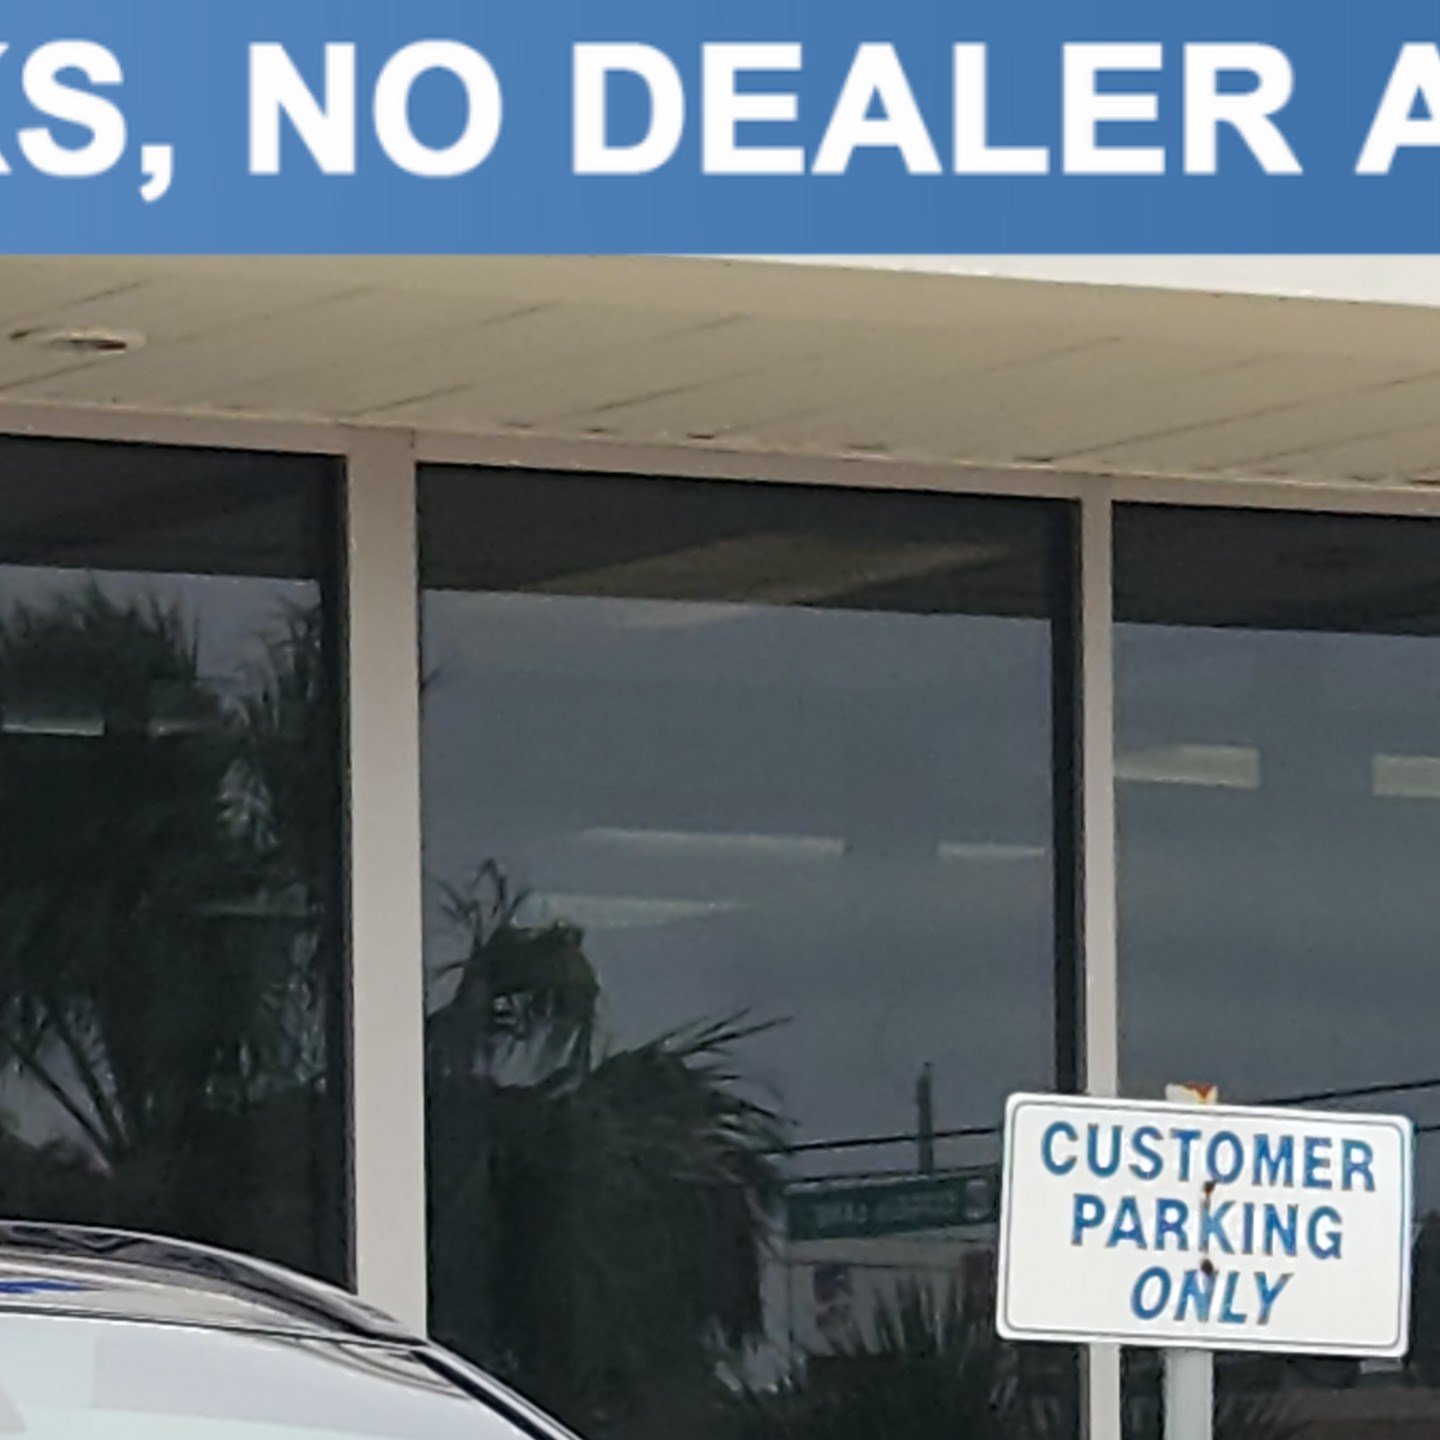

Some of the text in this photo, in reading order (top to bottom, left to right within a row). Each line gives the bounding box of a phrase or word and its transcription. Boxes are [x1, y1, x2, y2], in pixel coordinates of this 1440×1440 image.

[1041, 1120, 1377, 1193] CUSTOMER
[1070, 1193, 1344, 1261] PARKING
[1130, 1265, 1296, 1325] ONLY
